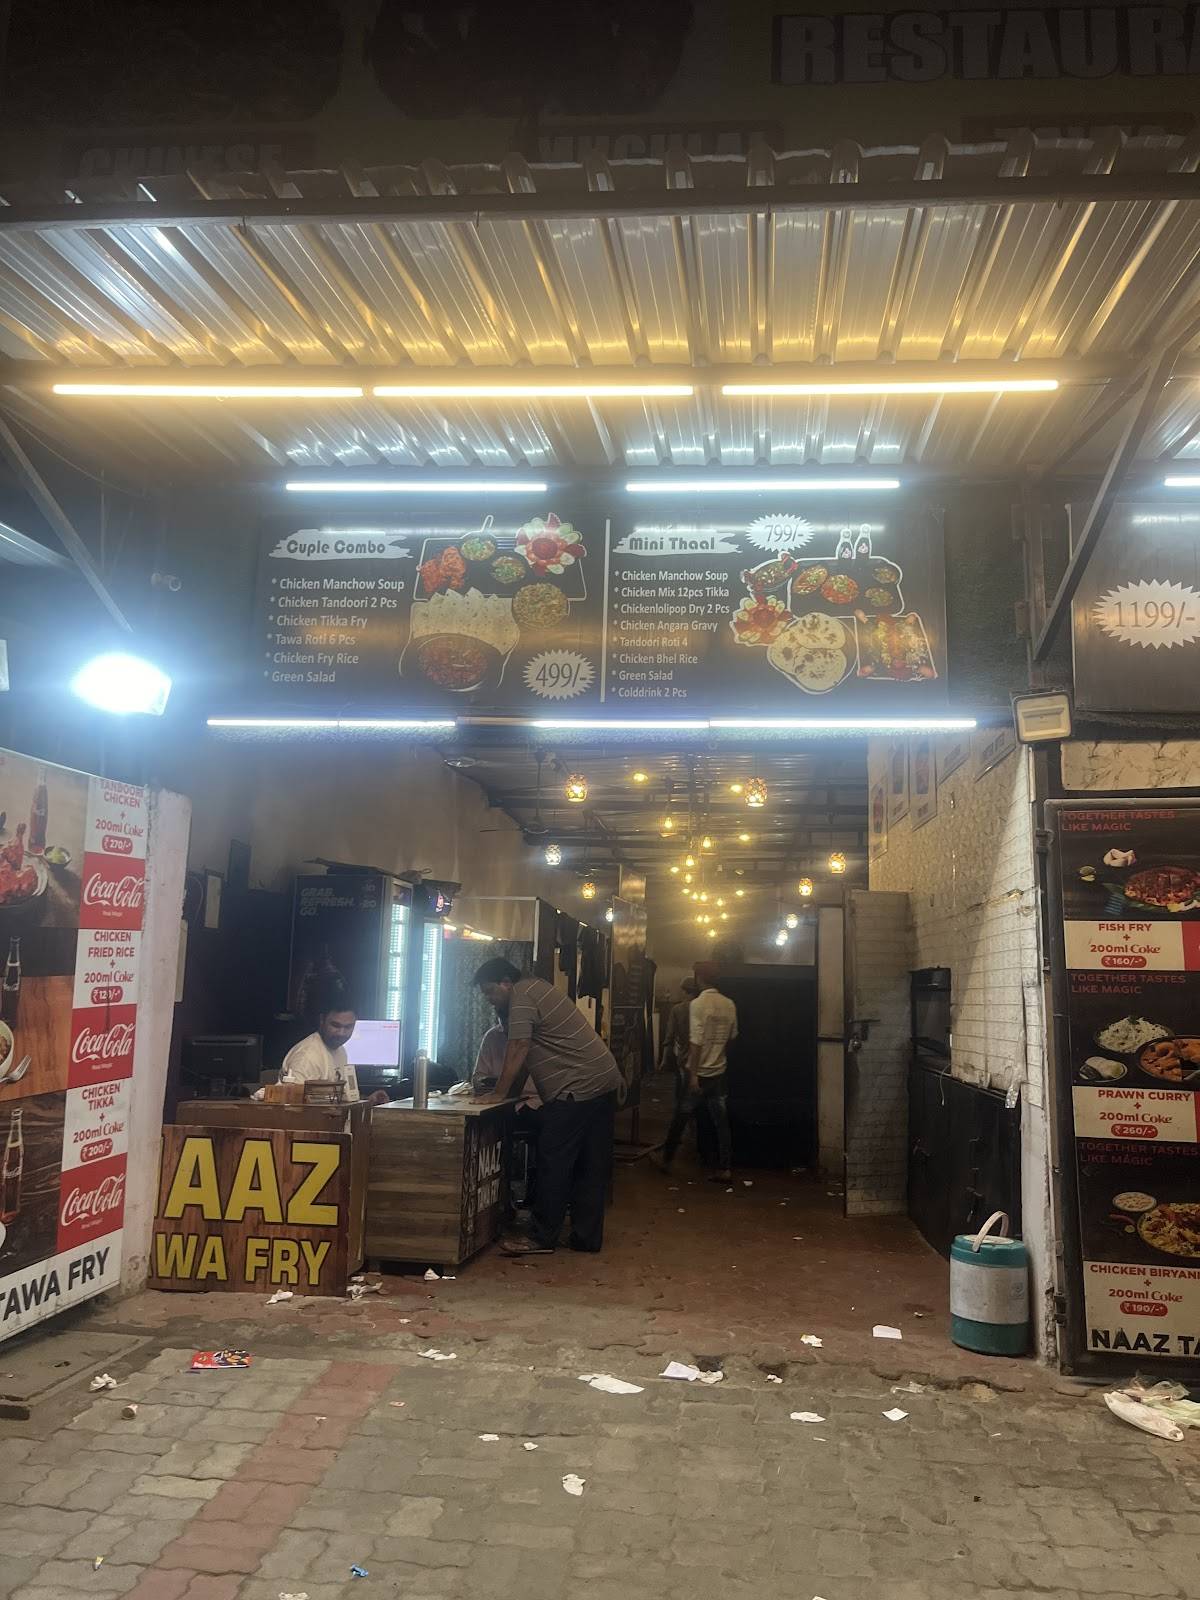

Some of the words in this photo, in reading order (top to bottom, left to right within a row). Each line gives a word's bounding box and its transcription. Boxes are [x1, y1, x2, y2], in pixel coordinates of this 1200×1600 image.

[772, 8, 1200, 84] RESTAUR
[764, 523, 804, 543] 799/-
[287, 539, 330, 557] Cuple
[334, 539, 386, 554] Combo
[629, 537, 664, 551] Mini
[669, 537, 715, 551] Thaal
[622, 571, 656, 581] Chicken
[658, 571, 703, 581] Manchow
[705, 571, 729, 583] Soup
[280, 578, 320, 590] Chicken
[323, 579, 376, 590] Manchow
[378, 579, 405, 592] Soup
[621, 587, 656, 597] Chicken
[658, 587, 676, 597] Mix
[678, 587, 704, 600] 12pcs
[706, 587, 730, 597] Tikka
[278, 596, 319, 608] Chicken
[322, 596, 368, 608] Tandoori
[371, 597, 378, 608] 2
[381, 597, 398, 608] Pcs
[621, 603, 687, 617] Chickenlolipop
[689, 604, 705, 617] Dry
[707, 604, 713, 614] 2
[715, 604, 730, 614] Pcs
[1113, 601, 1196, 628] 1199/-
[277, 615, 317, 627] Chicken
[320, 616, 348, 627] Tikka
[351, 616, 368, 629] Fry
[620, 620, 655, 631] Chicken
[657, 621, 689, 633] Angara
[691, 621, 718, 633] Gravy
[275, 634, 303, 645] Tawa
[305, 633, 327, 645] Roti
[330, 634, 336, 645] 6
[339, 634, 356, 645] Pcs
[620, 637, 659, 647] Tandoori
[661, 637, 681, 647] Roti
[682, 638, 688, 647] 4
[274, 652, 314, 664] Chicken
[318, 653, 334, 666] Fry
[337, 653, 359, 664] Rice
[619, 653, 654, 664] Chicken
[656, 653, 677, 664] Bhel
[679, 653, 698, 664] Rice
[272, 671, 304, 682] Green
[307, 671, 336, 682] Salad
[536, 663, 587, 688] 499/-
[618, 670, 646, 681] Green
[649, 670, 673, 681] Salad
[618, 687, 662, 698] Colddrink
[664, 688, 670, 697] 2
[672, 688, 687, 698] Pcs
[103, 792, 141, 808] CHICKEN
[1062, 810, 1127, 821] TOGETHER
[1130, 810, 1176, 820] TASTES
[95, 818, 123, 833] 200ml
[123, 821, 144, 837] Coke
[1062, 823, 1088, 832] LIKE
[1091, 823, 1131, 832] MAGIC
[1098, 923, 1125, 931] FISH
[1128, 923, 1152, 931] FRY
[94, 931, 132, 942] CHICKEN
[88, 946, 114, 958] FRIED
[115, 946, 135, 958] RICE
[1090, 944, 1128, 953] 200ml
[1130, 944, 1160, 954] Coke
[84, 971, 112, 984] 200ml
[113, 970, 135, 983] Coke
[1071, 974, 1137, 983] TOGETHER
[1139, 975, 1185, 984] TASTES
[1071, 985, 1098, 994] LIKE
[1101, 985, 1142, 994] MAGIC
[81, 1083, 121, 1100] CHICKEN
[1098, 1089, 1145, 1099] PRAWN
[1148, 1092, 1191, 1102] CURRY
[88, 1096, 115, 1111] TIKKA
[1099, 1112, 1139, 1122] 200ml
[1141, 1113, 1173, 1124] Coke
[73, 1125, 103, 1144] 200ml
[103, 1121, 125, 1136] Coke
[160, 1136, 341, 1226] AAZ
[155, 1232, 229, 1282] WA
[245, 1237, 332, 1285] FRY
[68, 1246, 110, 1291] FRY
[1090, 1264, 1146, 1276] CHICKEN
[1150, 1268, 1200, 1280] BIRYANI
[1108, 1288, 1149, 1299] 200ml
[1151, 1290, 1183, 1303] Coke
[1091, 1328, 1170, 1354] NAAZ
